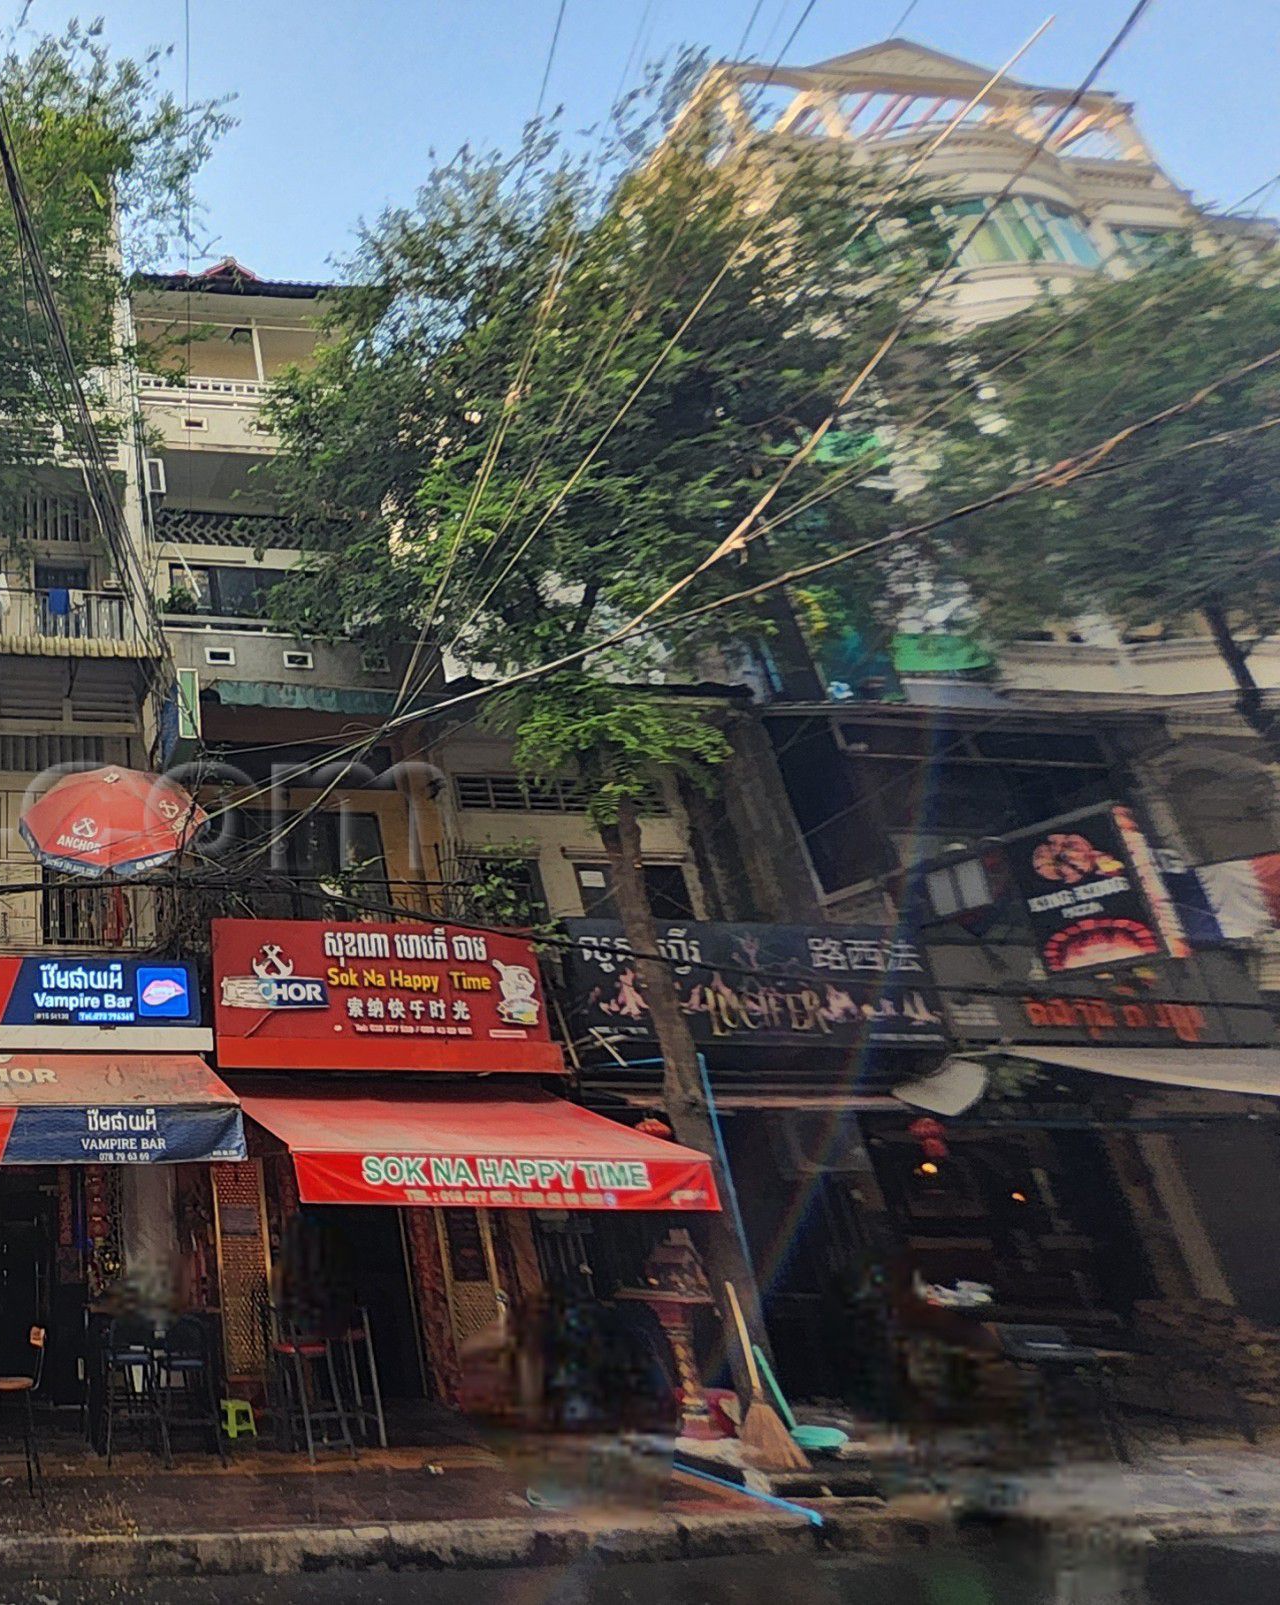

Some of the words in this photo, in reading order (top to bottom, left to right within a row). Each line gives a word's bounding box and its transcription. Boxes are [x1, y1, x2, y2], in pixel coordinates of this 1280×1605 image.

[56, 834, 102, 855] ANCHOR
[807, 936, 924, 973] 路西法
[327, 966, 360, 987] Sok
[362, 967, 386, 988] Na
[389, 969, 440, 993] Happy
[449, 970, 492, 991] Time
[33, 992, 100, 1011] Vampire
[103, 993, 133, 1009] Bar
[81, 1138, 138, 1150] VAMPIRE
[140, 1138, 167, 1150] BAR
[361, 1155, 429, 1188] SOK
[430, 1157, 477, 1188] NA
[476, 1158, 575, 1189] HAPPY
[576, 1160, 651, 1191] TIME
